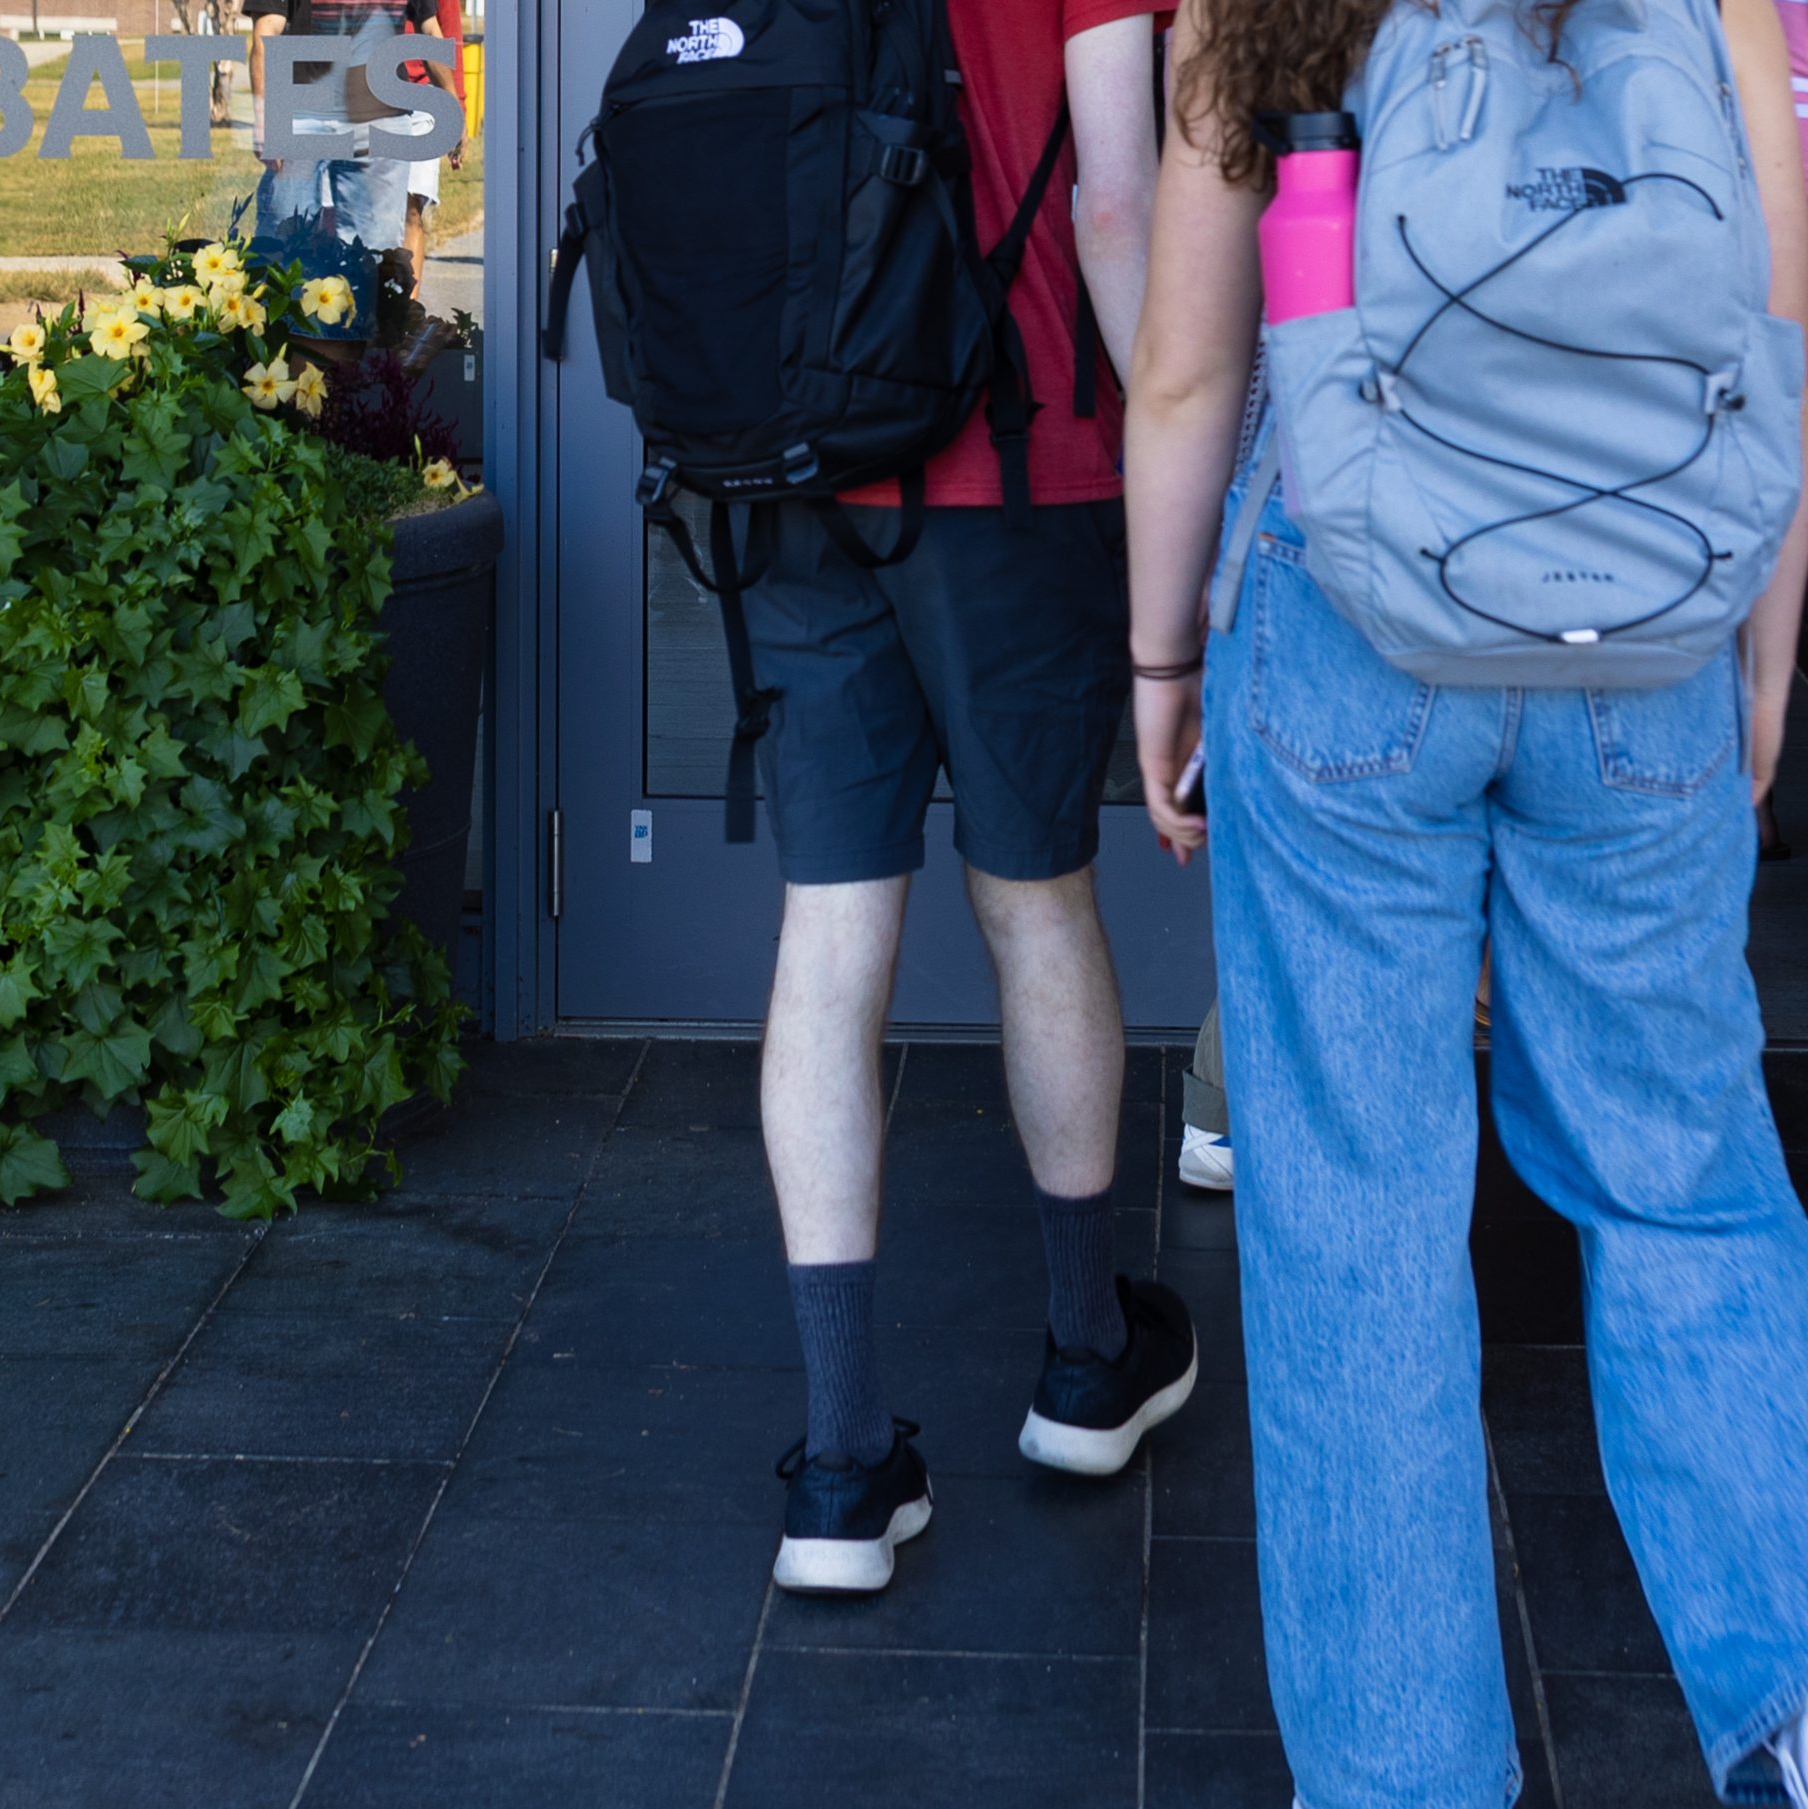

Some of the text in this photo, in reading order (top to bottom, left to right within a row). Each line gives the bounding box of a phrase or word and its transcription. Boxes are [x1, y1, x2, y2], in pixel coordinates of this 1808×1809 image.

[689, 18, 719, 36] THE
[666, 34, 718, 54] NORTH
[1536, 167, 1583, 183] THE
[1505, 181, 1585, 202] NORTH
